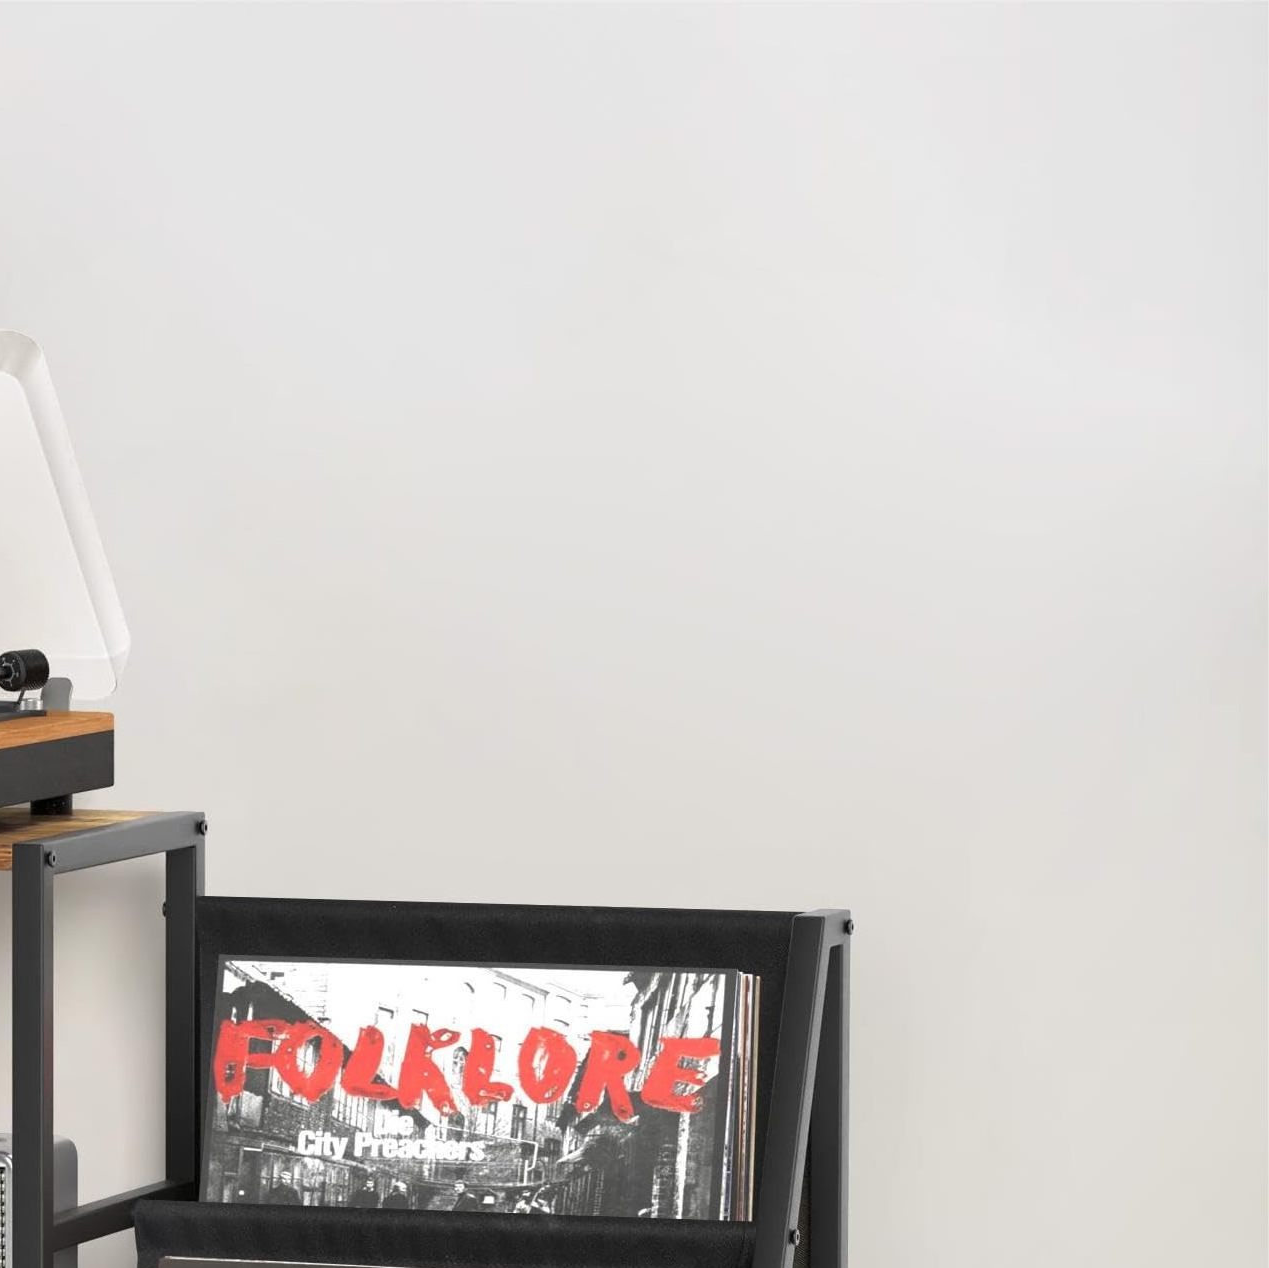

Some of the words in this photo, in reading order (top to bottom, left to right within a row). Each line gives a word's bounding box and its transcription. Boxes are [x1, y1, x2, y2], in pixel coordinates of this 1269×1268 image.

[214, 1018, 721, 1121] FOLKLORE
[297, 1129, 349, 1160] City
[353, 1131, 487, 1161] Preachers
